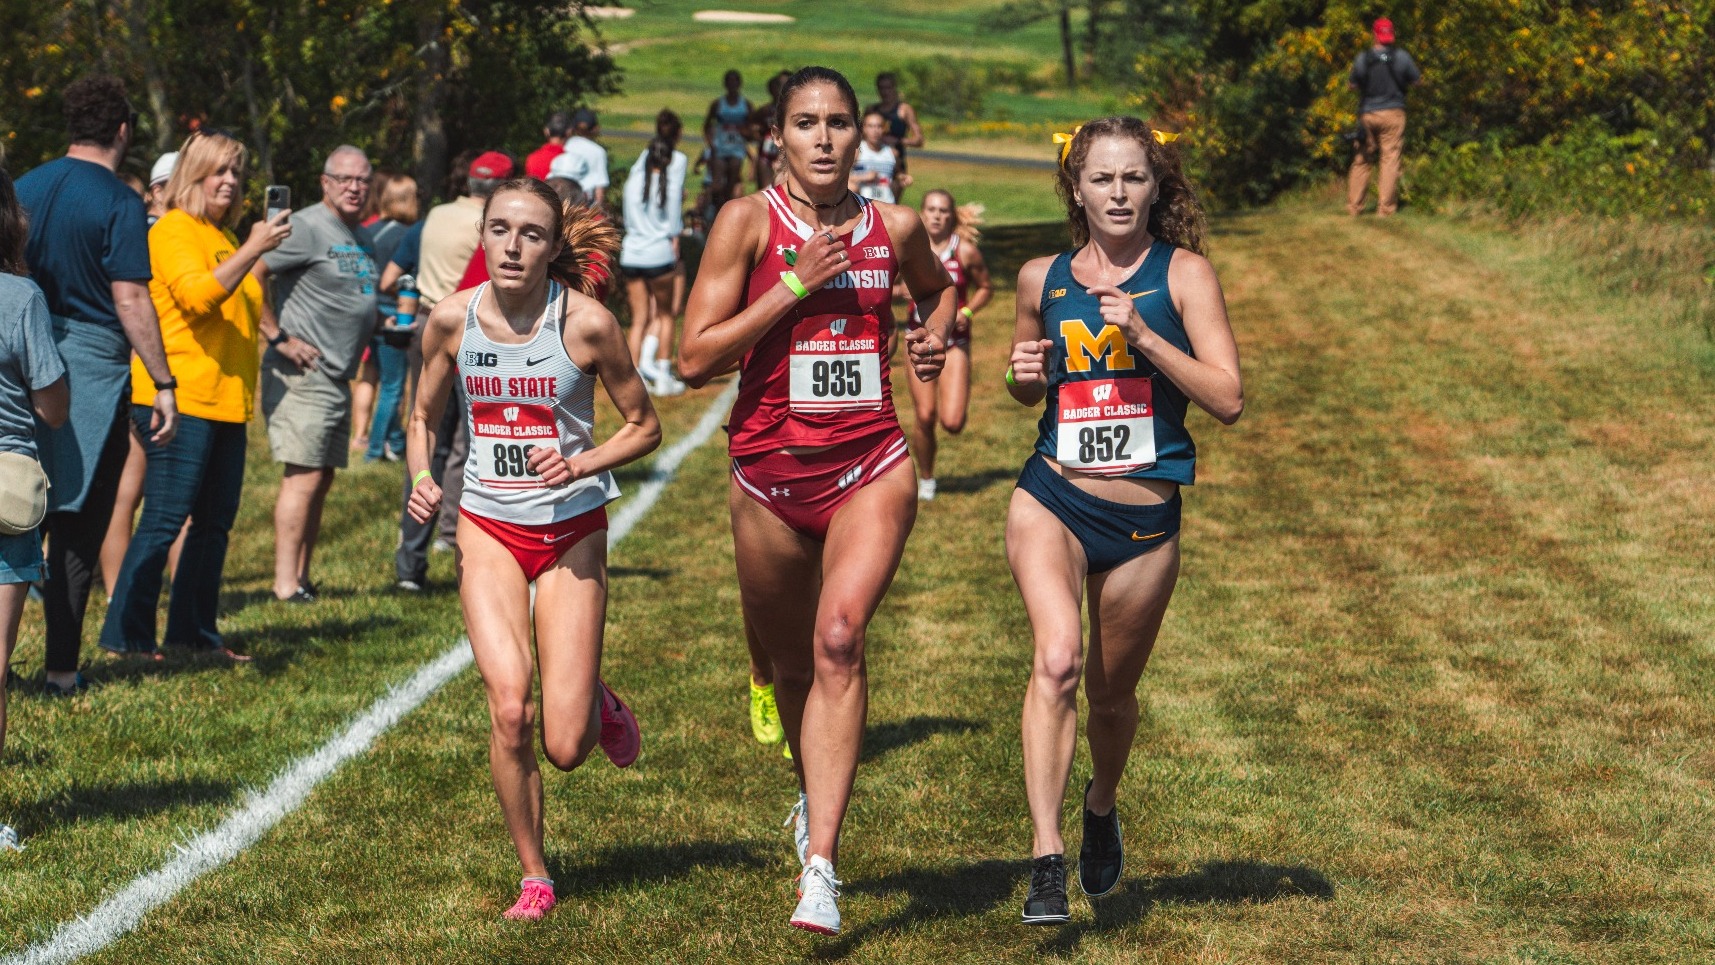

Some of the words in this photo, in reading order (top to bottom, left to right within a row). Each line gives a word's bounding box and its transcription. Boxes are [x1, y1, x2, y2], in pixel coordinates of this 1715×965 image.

[779, 270, 889, 289] ONSIN
[795, 340, 836, 351] BADGER
[838, 339, 875, 351] CLASSIC
[1060, 319, 1136, 373] M
[466, 375, 502, 396] OHIO
[509, 377, 557, 397] STATE
[812, 360, 861, 397] 935
[1063, 407, 1101, 420] BADGER
[1104, 403, 1147, 417] CLASSIC
[478, 424, 511, 436] BADGER
[513, 425, 553, 436] CLASSIC
[1078, 424, 1131, 464] 852
